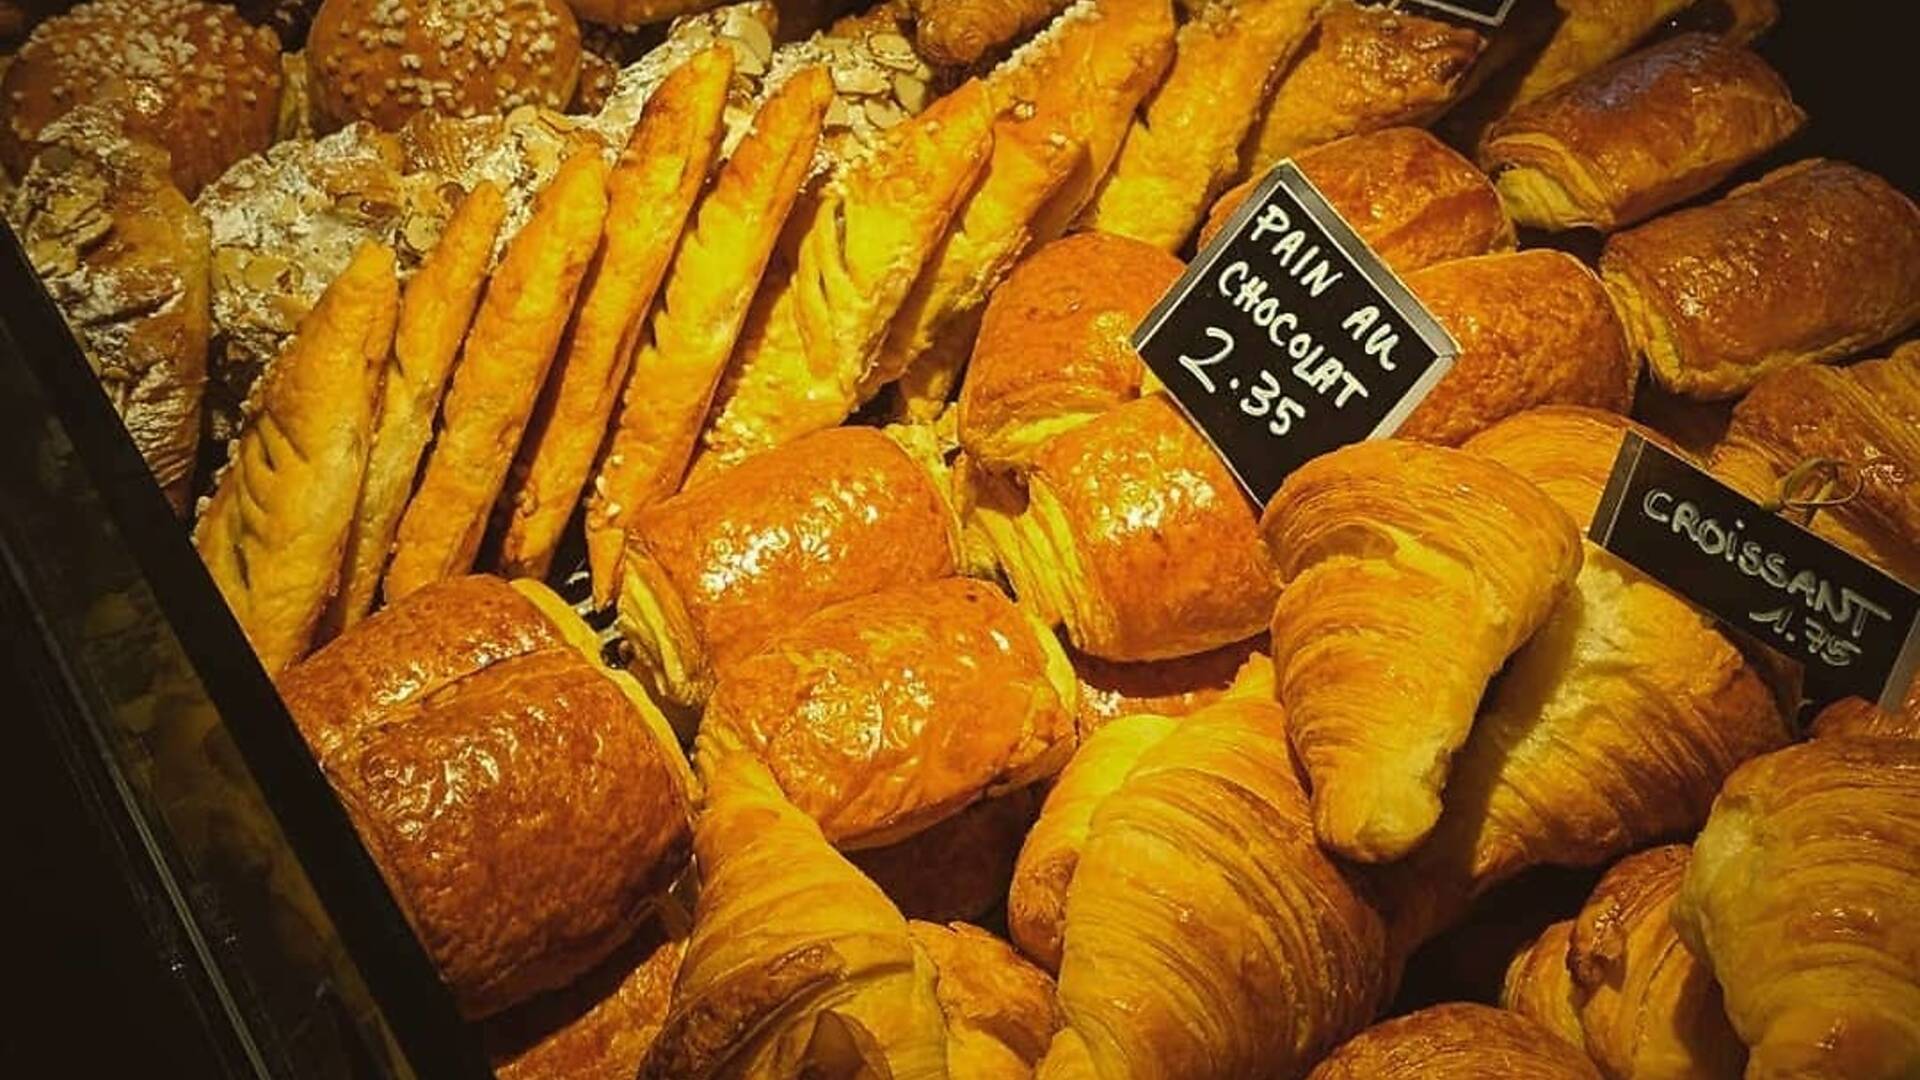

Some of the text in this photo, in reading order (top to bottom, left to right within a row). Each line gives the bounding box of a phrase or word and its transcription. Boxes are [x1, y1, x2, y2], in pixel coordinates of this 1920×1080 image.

[1251, 203, 1343, 297] PAIN
[1179, 327, 1305, 436] 2.35
[1218, 261, 1368, 408] CHOCOLAT
[1749, 607, 1862, 667] 1.75
